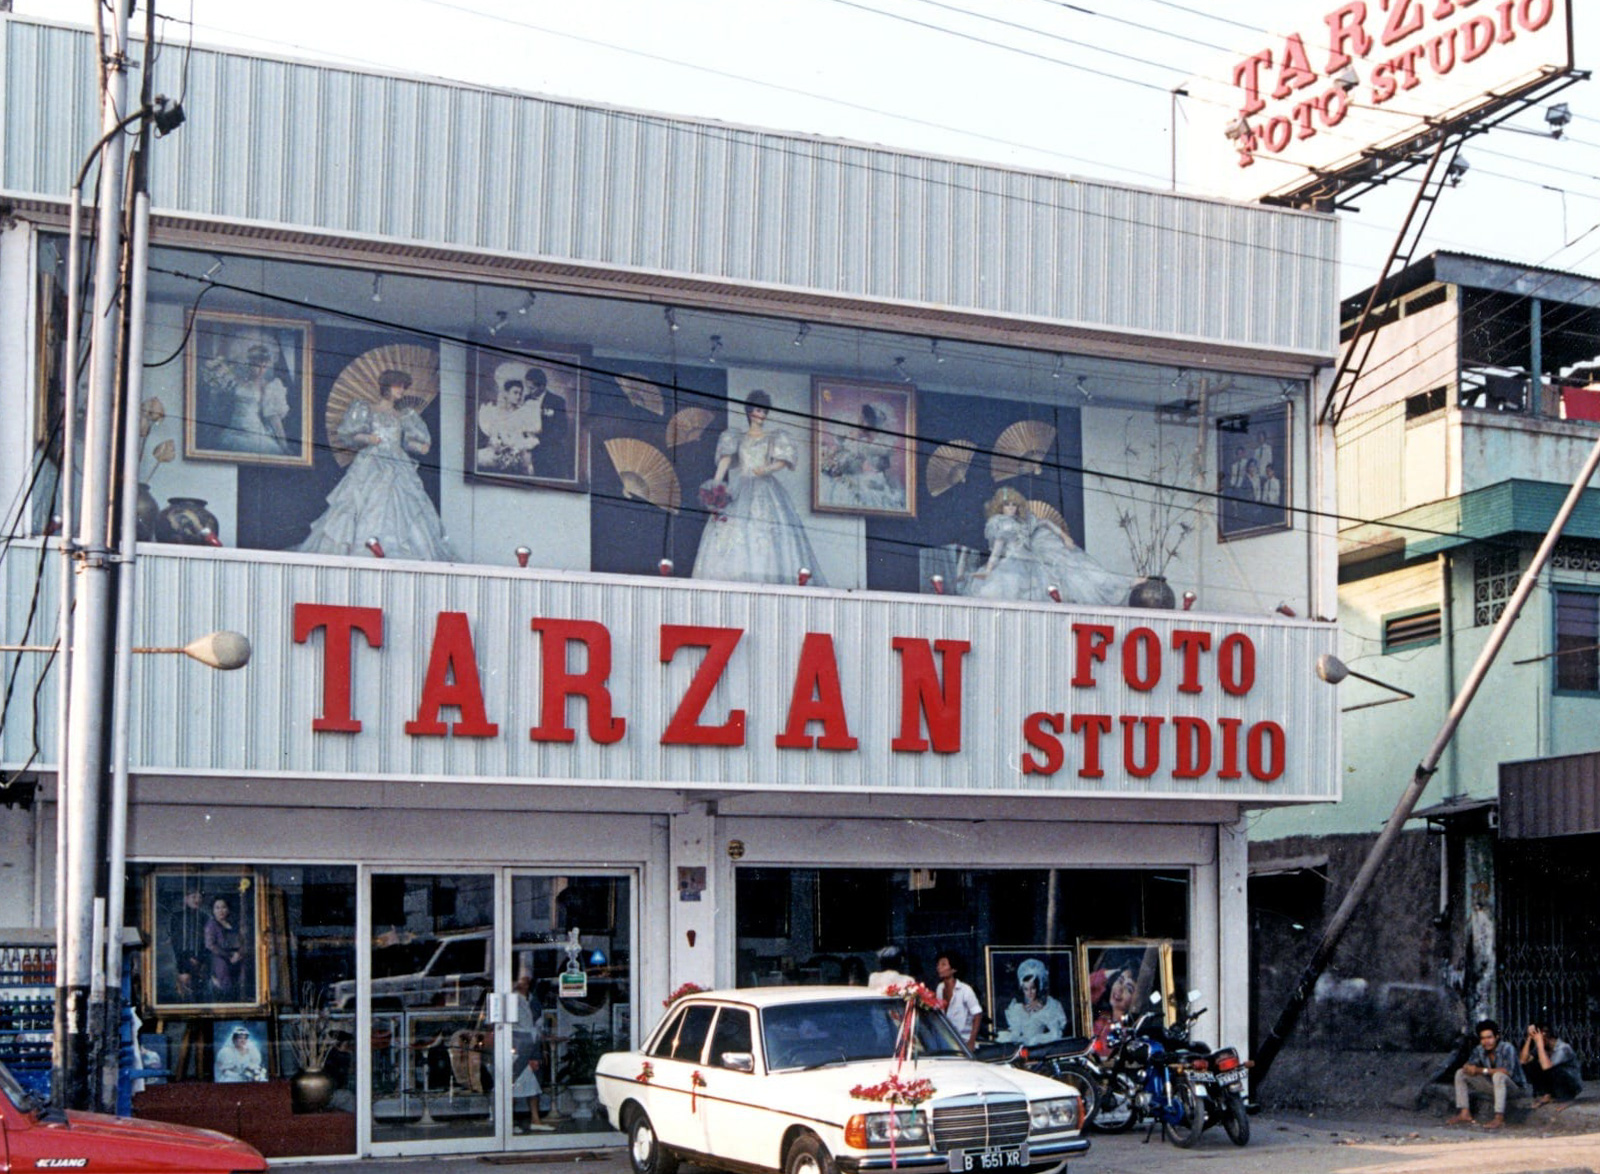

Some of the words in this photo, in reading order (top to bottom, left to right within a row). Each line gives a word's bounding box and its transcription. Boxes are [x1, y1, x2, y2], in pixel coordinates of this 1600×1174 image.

[1233, 0, 1481, 118] TARZ
[1370, 0, 1554, 105] STUDIO
[293, 602, 971, 753] TARZAN
[1071, 623, 1256, 696] FOTO
[1022, 711, 1286, 782] STUDIO
[964, 1155, 973, 1171] B
[981, 1153, 1003, 1168] 1551
[1006, 1151, 1020, 1166] XR
